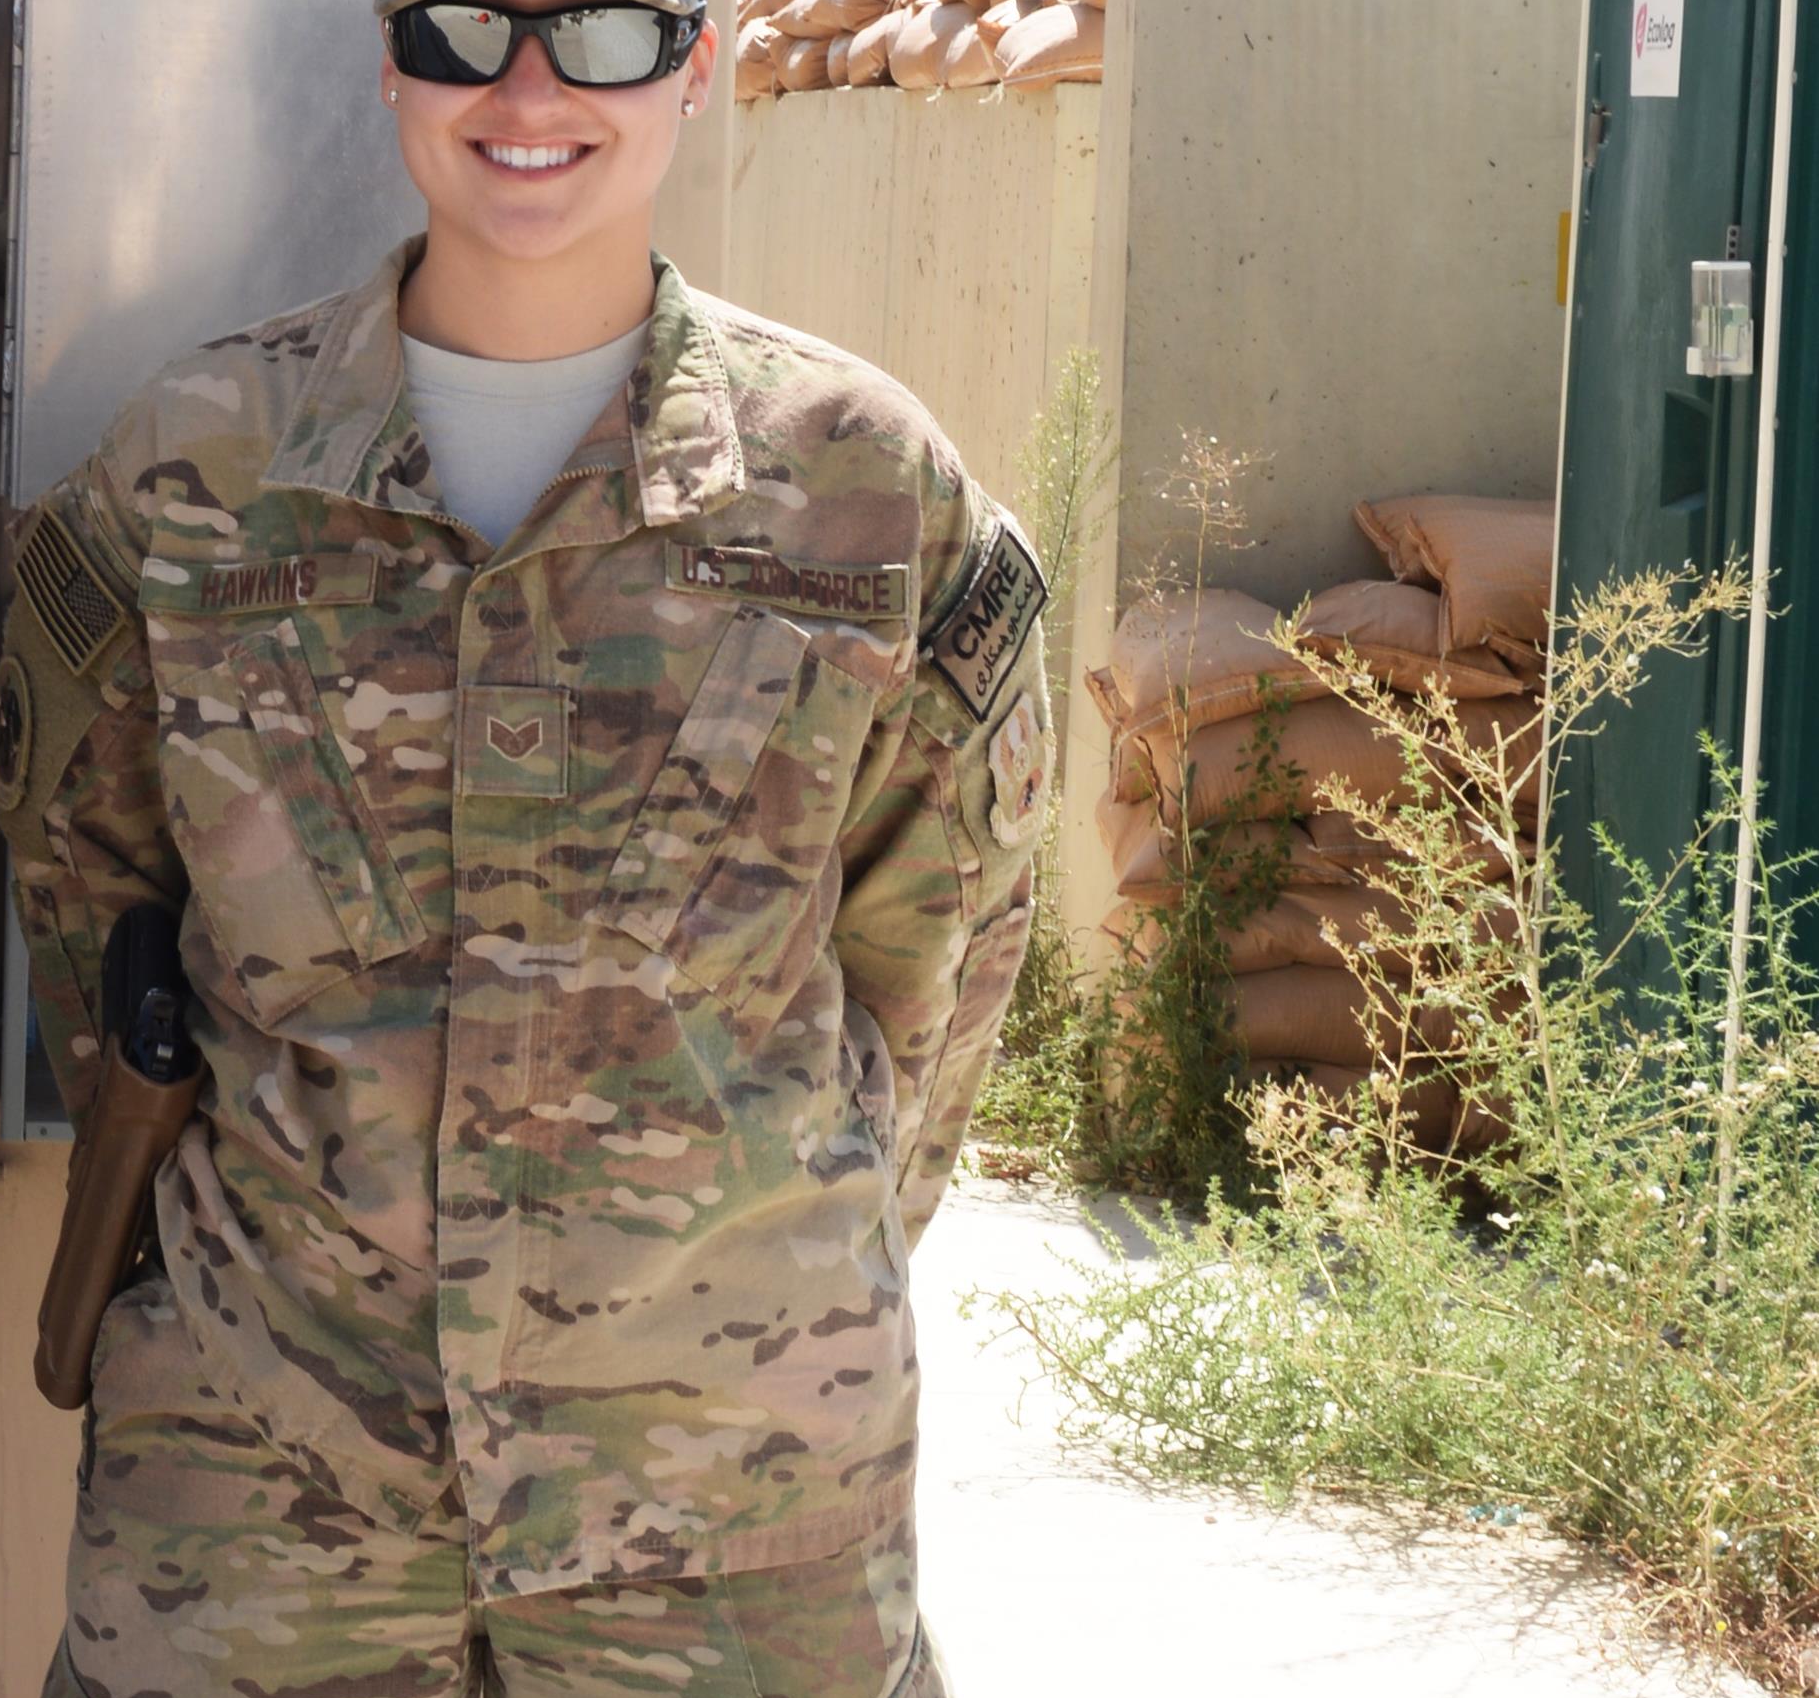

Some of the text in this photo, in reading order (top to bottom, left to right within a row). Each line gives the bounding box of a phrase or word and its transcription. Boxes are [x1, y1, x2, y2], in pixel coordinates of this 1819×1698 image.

[200, 560, 318, 608] HAWKINS
[798, 568, 891, 612] FORCE
[951, 548, 1021, 660] CMRE
